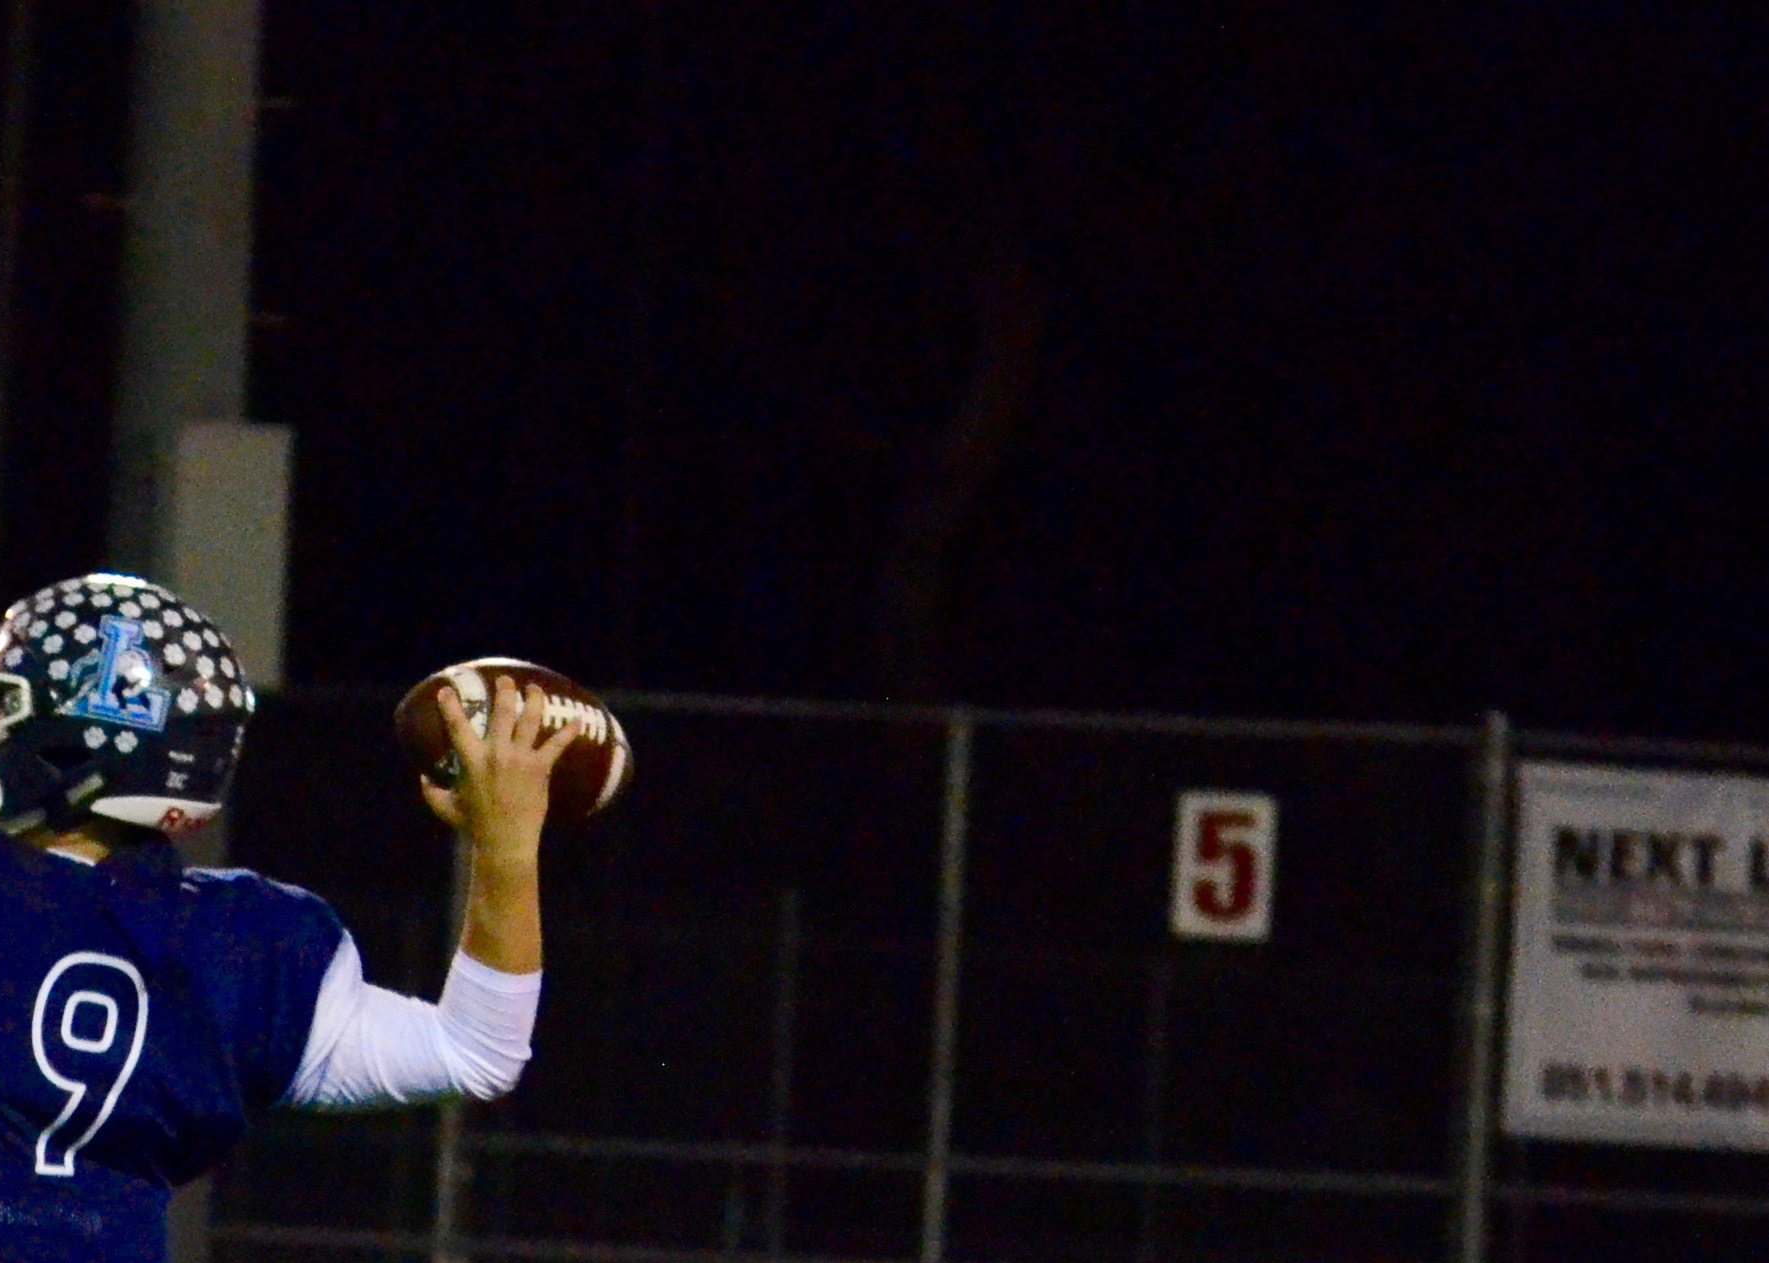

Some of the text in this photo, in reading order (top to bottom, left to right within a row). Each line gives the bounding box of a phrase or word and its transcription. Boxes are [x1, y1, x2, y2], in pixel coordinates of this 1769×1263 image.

[1193, 810, 1257, 923] 5
[1552, 824, 1726, 887] NEXT
[32, 951, 148, 1177] 9
